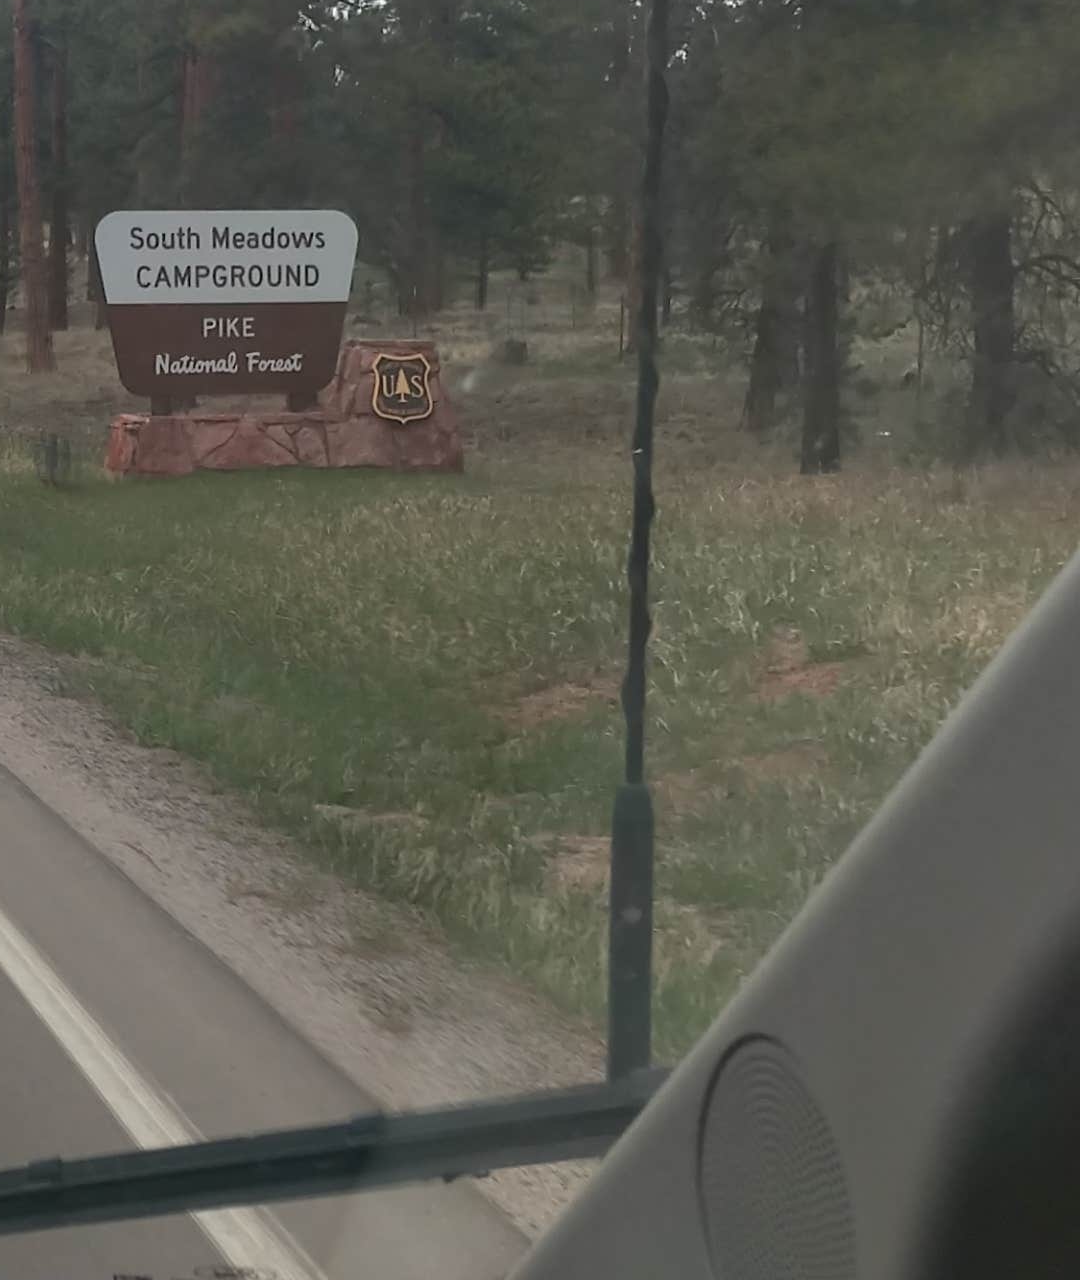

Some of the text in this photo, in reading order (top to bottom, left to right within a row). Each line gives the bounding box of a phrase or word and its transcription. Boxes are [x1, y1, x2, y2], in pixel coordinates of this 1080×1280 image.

[129, 226, 326, 250] South Meadows
[136, 264, 320, 288] CAMPGROUND
[202, 317, 256, 338] PIKE
[154, 351, 303, 375] National Forest
